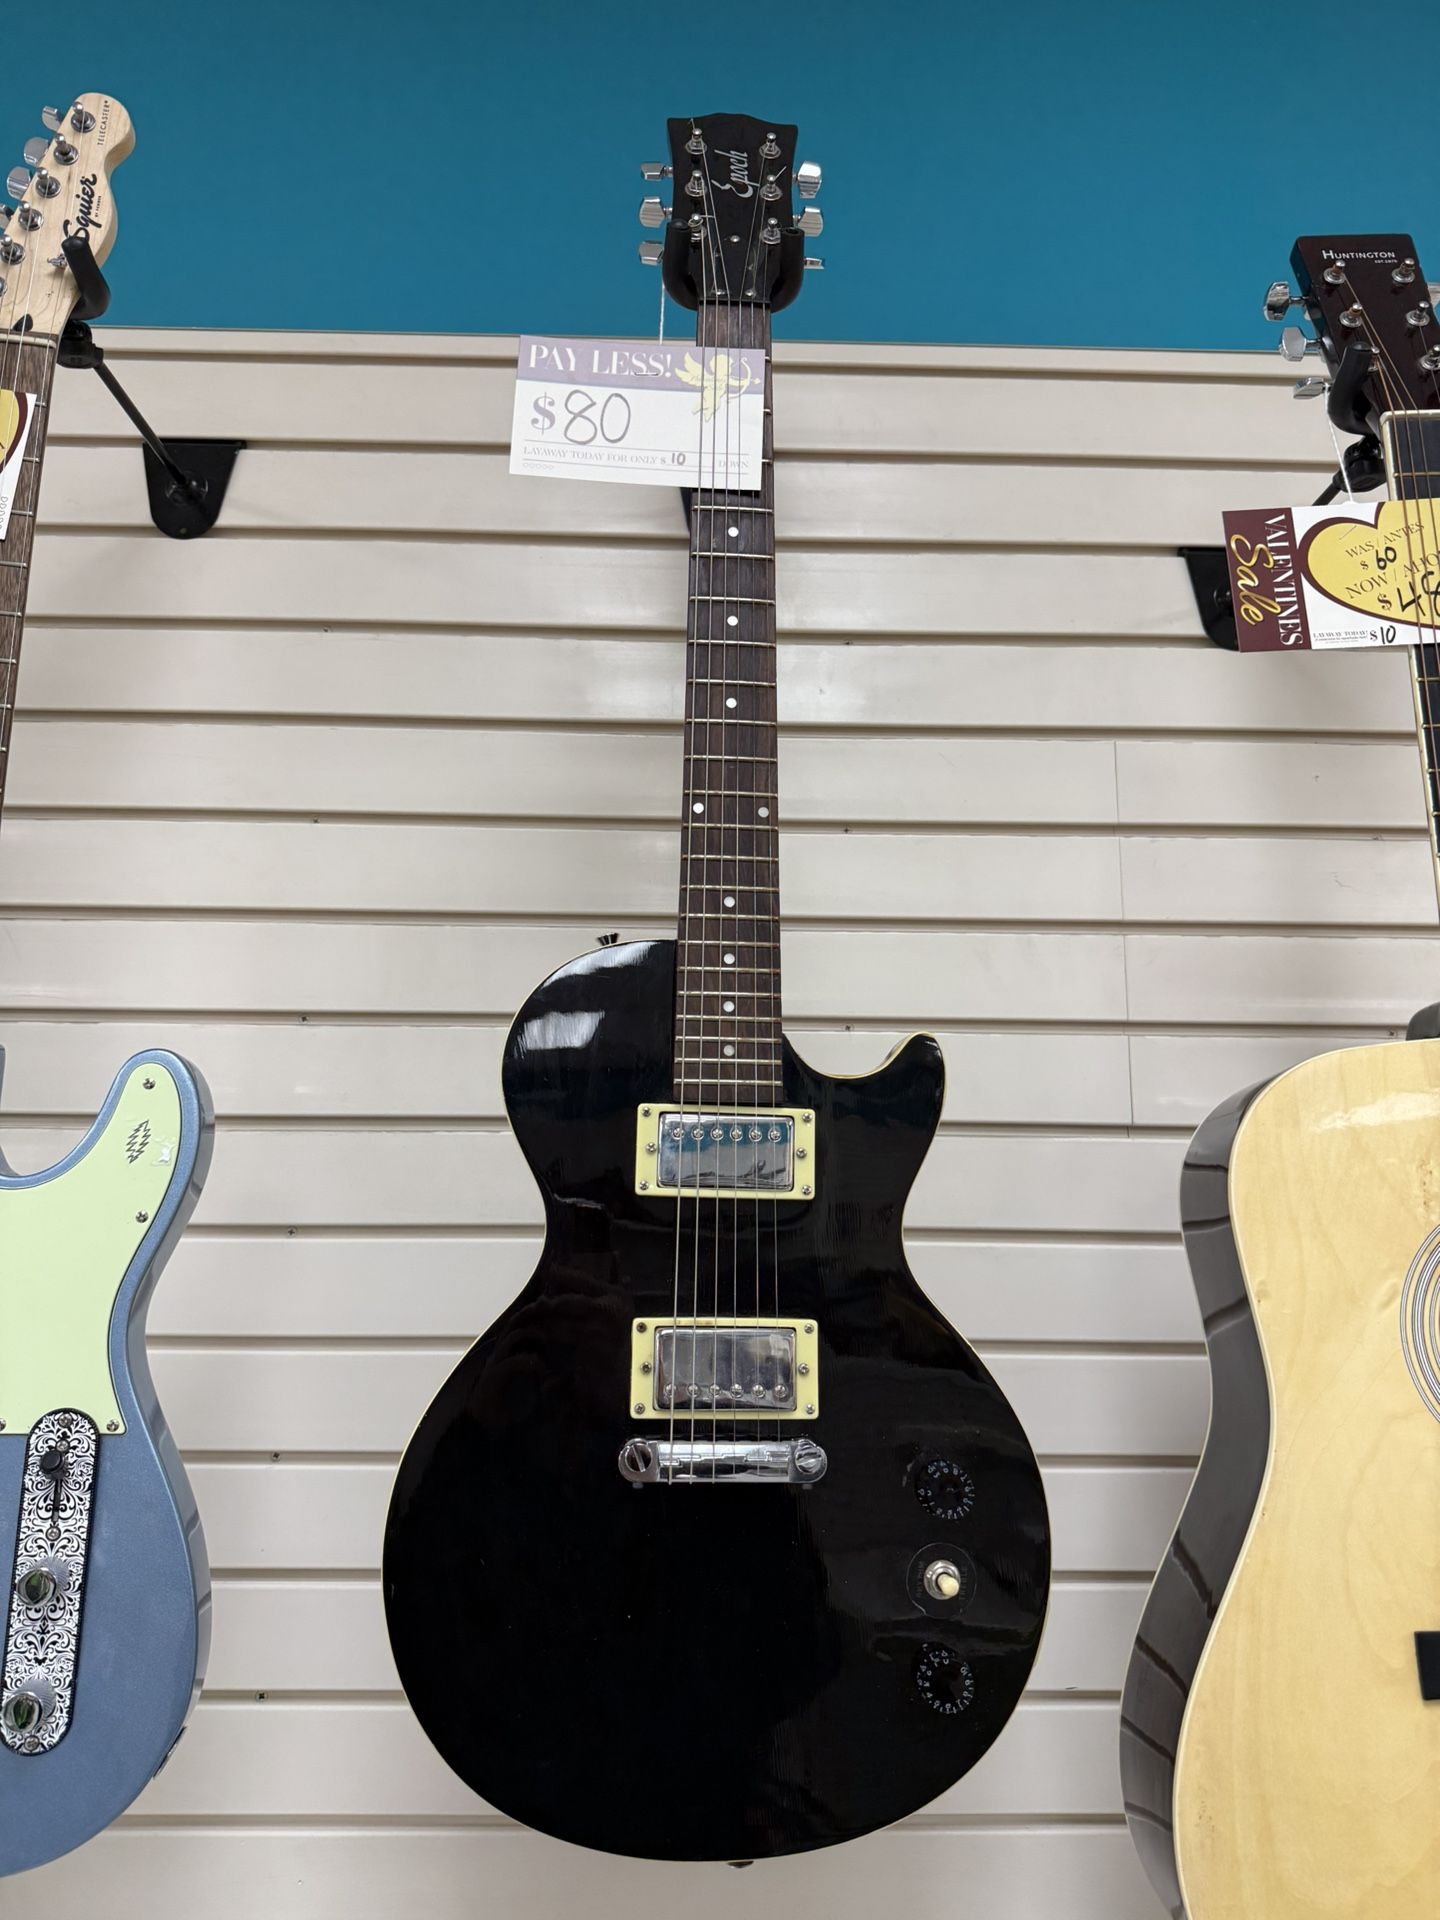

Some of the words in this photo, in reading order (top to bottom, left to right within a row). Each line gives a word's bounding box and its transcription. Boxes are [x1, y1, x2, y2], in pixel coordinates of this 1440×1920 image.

[711, 149, 761, 198] Epoch
[63, 173, 102, 245] Squier
[529, 344, 577, 372] PAY
[592, 349, 672, 378] LESS!
[523, 445, 568, 459] LAYAWAY
[570, 449, 605, 463] TODAY
[606, 452, 628, 464] FOR
[630, 453, 658, 466] ONLY
[1345, 540, 1375, 558] WAS
[1230, 534, 1282, 626] Sale
[1264, 514, 1304, 646] VALENTINES
[1345, 572, 1388, 599] NOW
